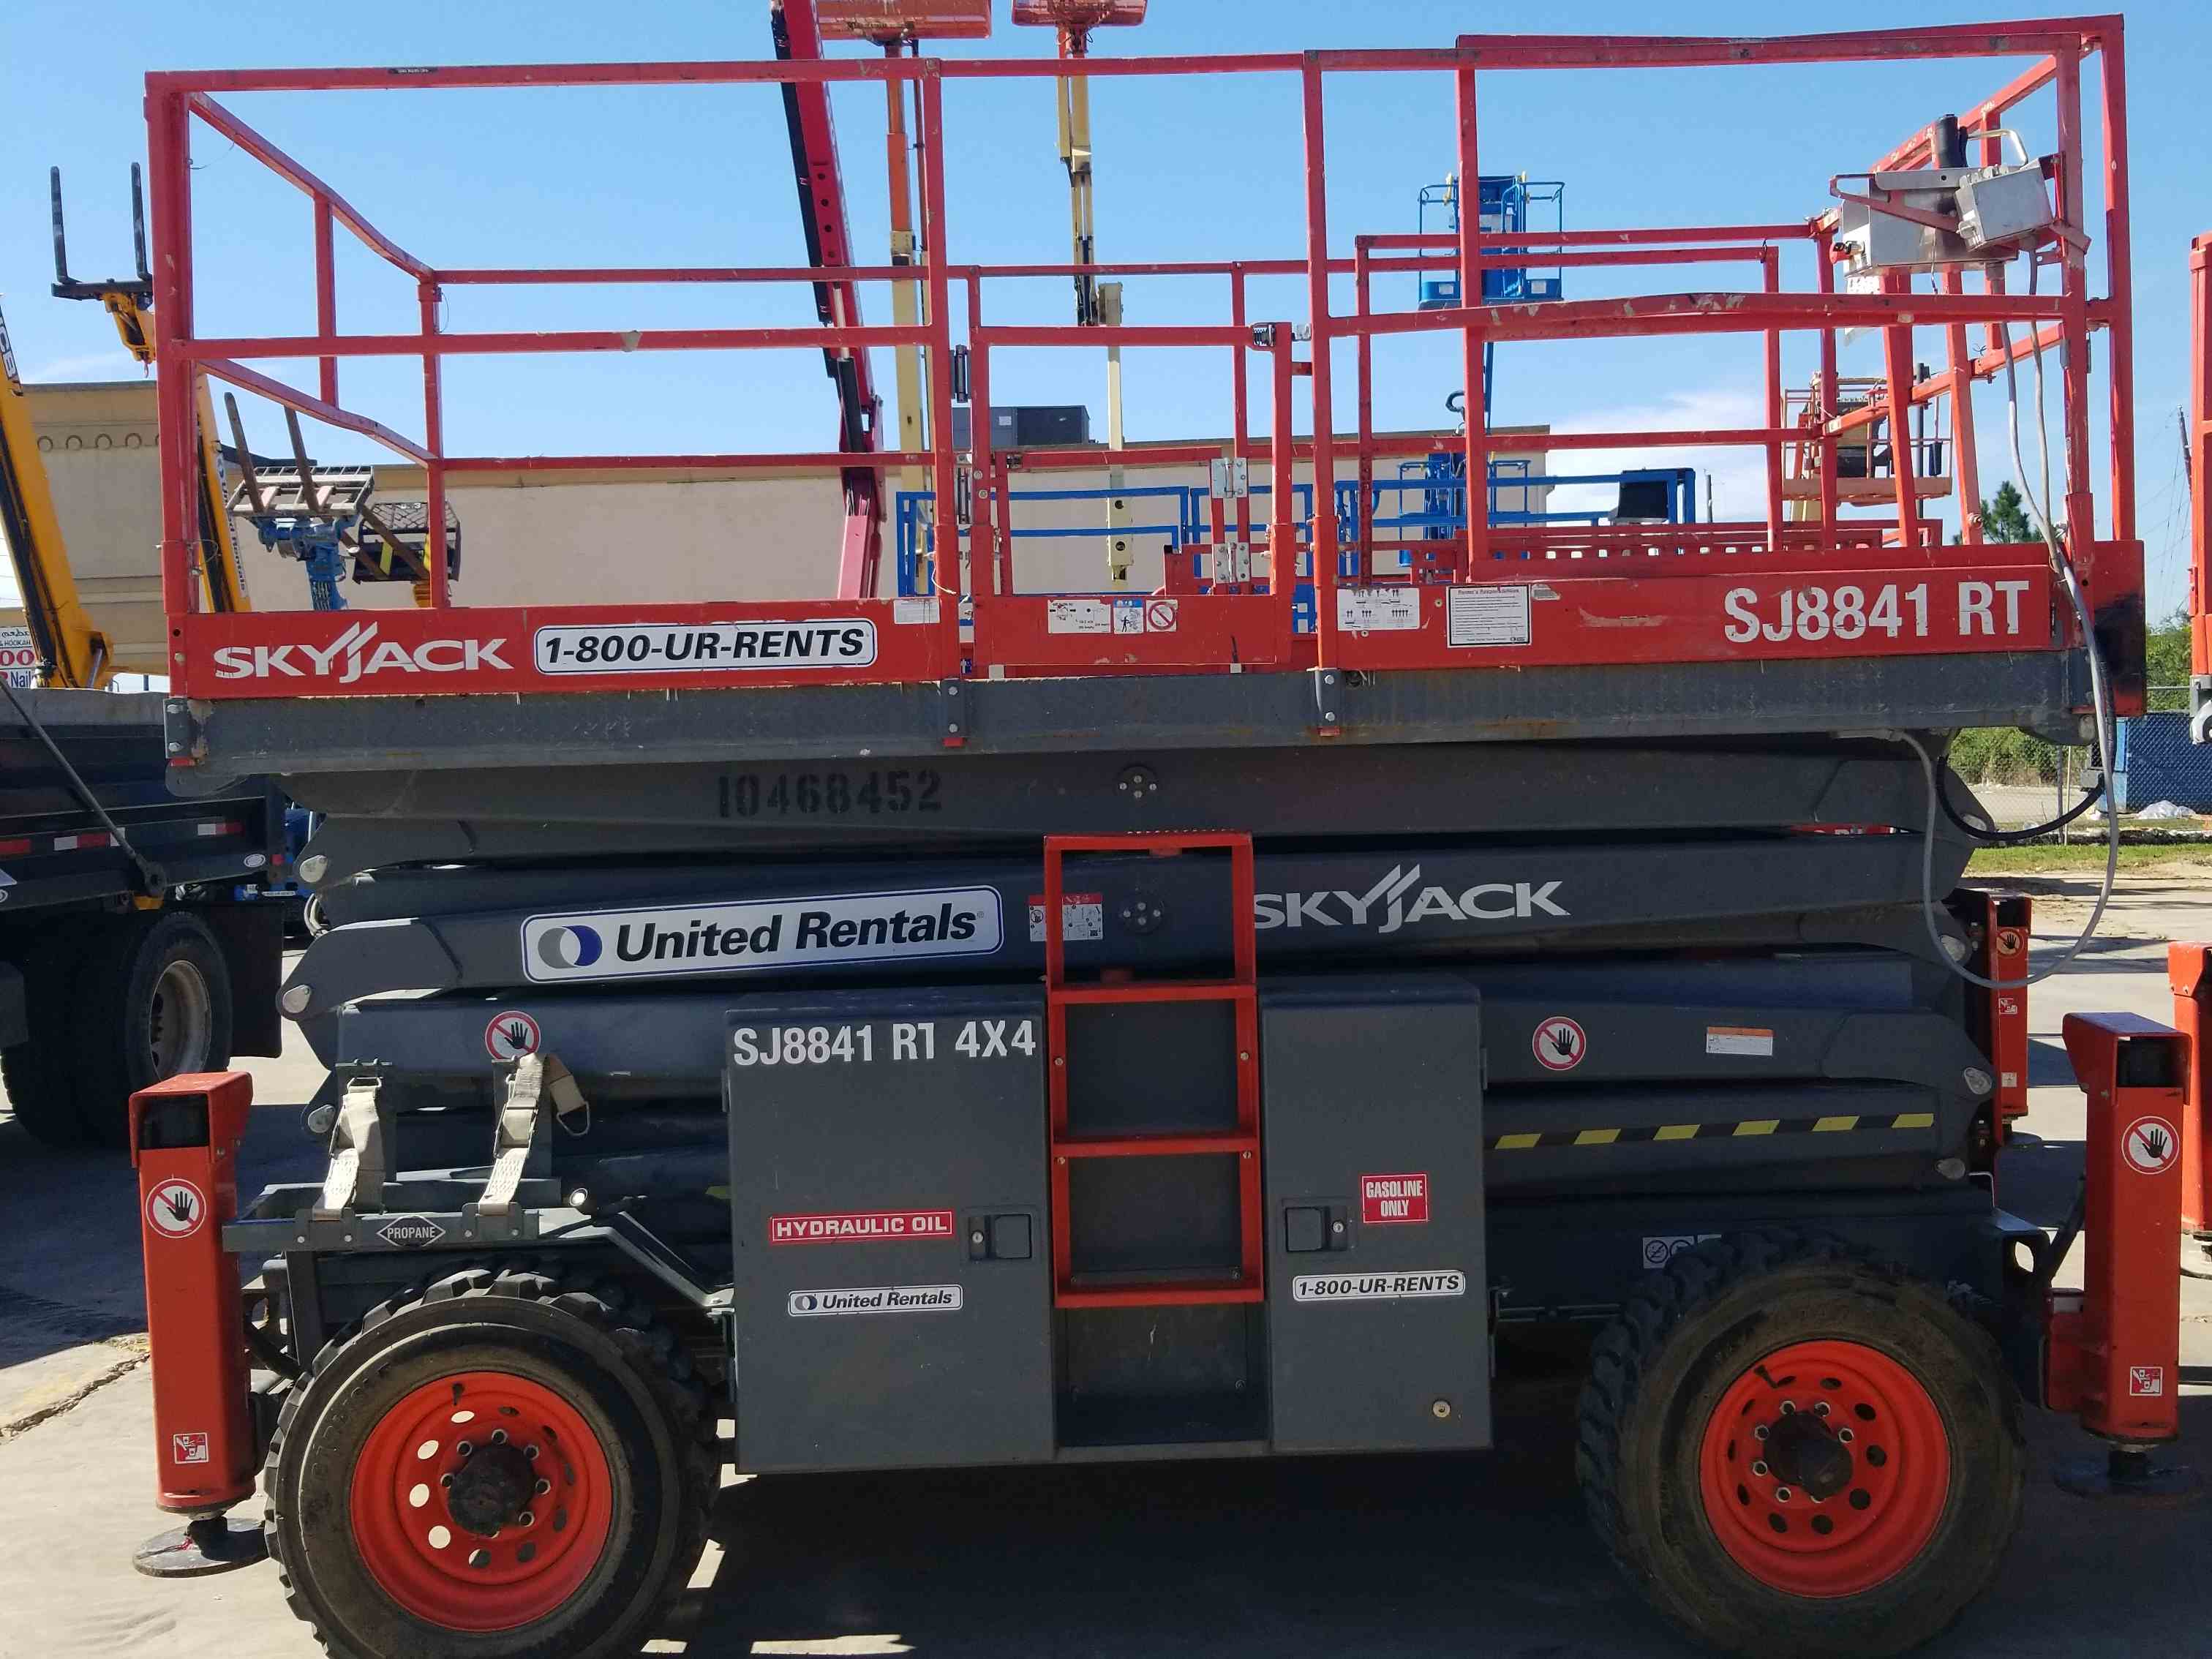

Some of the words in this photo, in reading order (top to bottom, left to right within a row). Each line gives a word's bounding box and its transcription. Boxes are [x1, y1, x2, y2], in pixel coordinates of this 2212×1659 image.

[1725, 582, 1927, 642] SJ8841
[1957, 580, 2030, 635] RT
[213, 621, 514, 684] SKYJACK
[544, 628, 865, 665] 1-800-UR-RENTS
[10, 671, 37, 688] Nail
[718, 770, 942, 818] 10468452
[1254, 864, 1570, 933] SKYJACK
[616, 914, 783, 963] United
[794, 902, 977, 949] Rentals
[734, 1024, 873, 1066] SJ8841
[955, 1020, 1037, 1058] 4X4
[1365, 1180, 1423, 1198] GASOLINE
[1380, 1200, 1410, 1217] ONLY
[387, 1226, 435, 1239] PROPANE
[776, 1219, 905, 1237] HYDRAULIC
[911, 1216, 947, 1231] OIL
[822, 1293, 884, 1309] United
[887, 1290, 953, 1306] Rentals
[1298, 1275, 1459, 1295] 1-800-UR-RENTS
